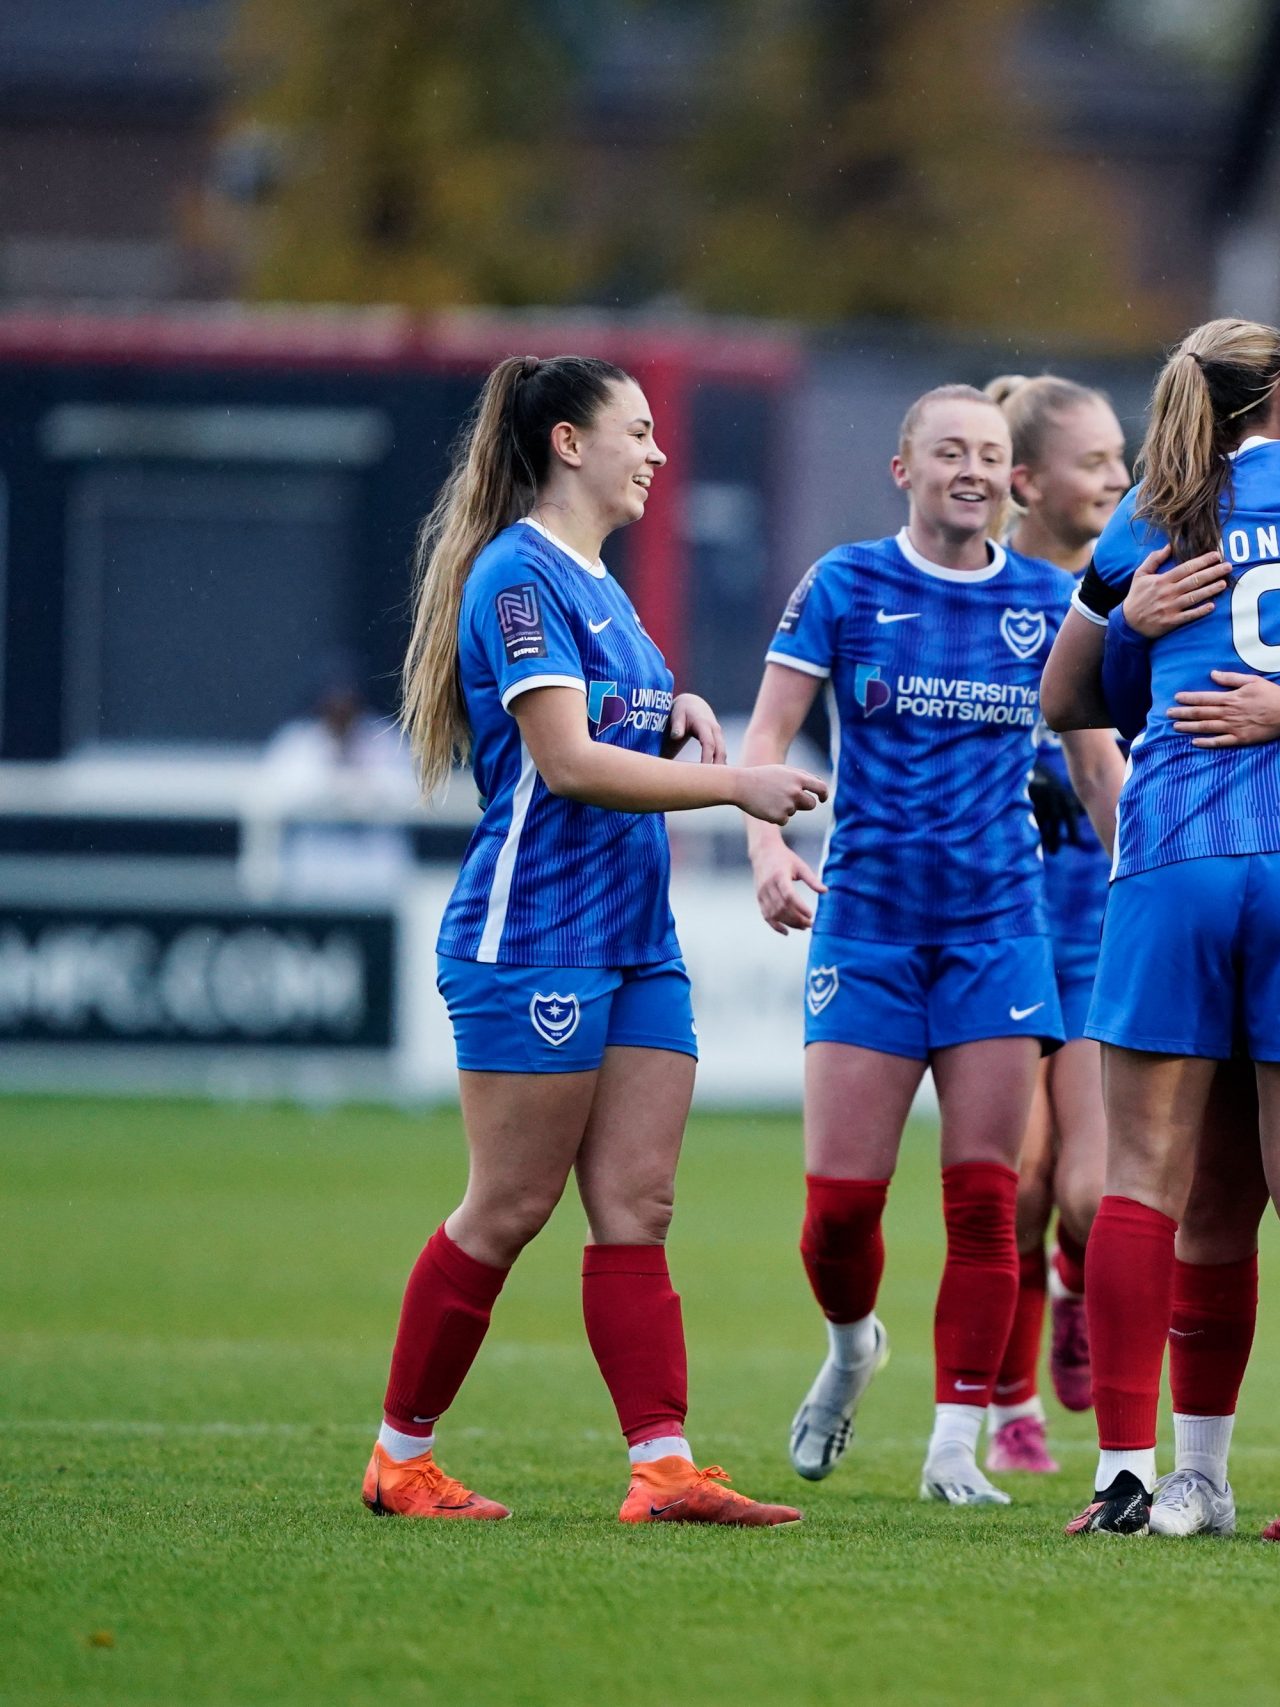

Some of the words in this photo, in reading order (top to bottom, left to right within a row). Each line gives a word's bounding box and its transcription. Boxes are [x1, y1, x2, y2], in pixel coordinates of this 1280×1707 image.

[513, 647, 539, 658] RESPECT
[632, 688, 673, 711] UNIVERS
[897, 675, 1030, 704] UNIVERSITY
[623, 710, 668, 733] PORTSM
[896, 696, 1034, 726] PORTSMOUTH
